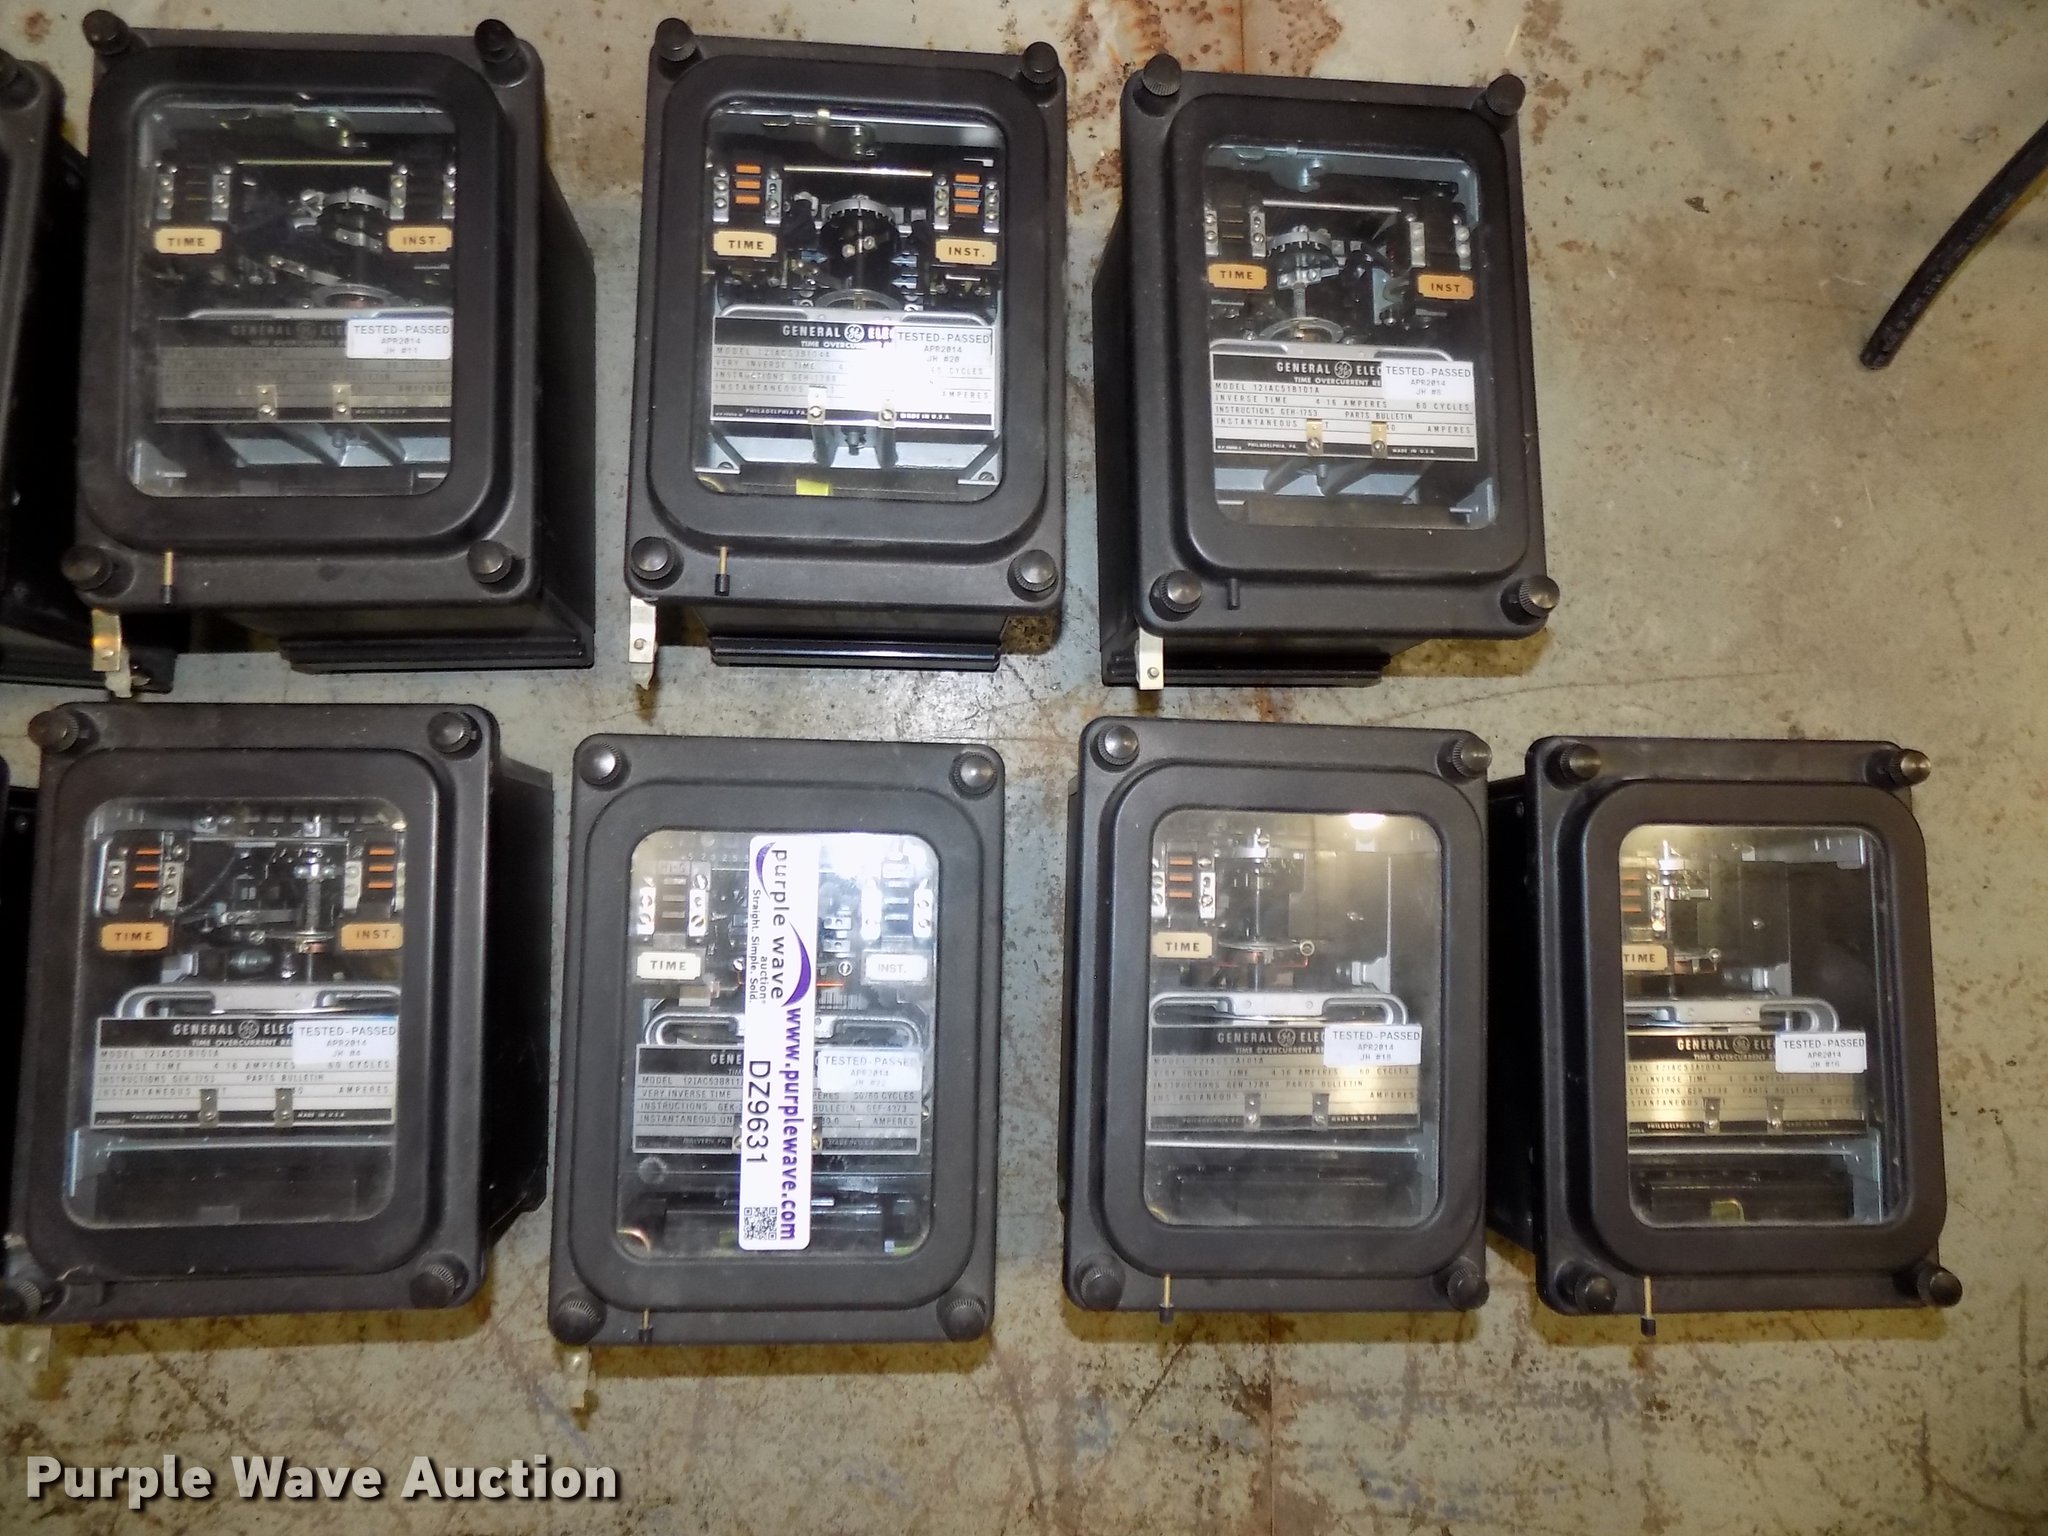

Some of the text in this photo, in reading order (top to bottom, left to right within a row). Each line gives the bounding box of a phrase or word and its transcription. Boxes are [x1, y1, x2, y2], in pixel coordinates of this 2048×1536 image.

[167, 236, 205, 248] TIME
[728, 240, 764, 250] TIME
[948, 246, 986, 258] INST.
[1220, 270, 1254, 280] TIME
[1430, 283, 1464, 292] INST.
[354, 325, 450, 334] TESTED-PASSED
[782, 325, 840, 338] GENERAL
[897, 332, 990, 344] TESTED-PASSED
[716, 347, 751, 356] MODEL
[716, 358, 738, 366] VERY
[747, 360, 786, 368] INVERSE
[794, 361, 815, 370] TIME
[1276, 362, 1331, 374] GENERAL
[715, 371, 785, 380] INSTRUCTIONS
[1386, 366, 1471, 378] TESTED-PASSED
[1215, 382, 1246, 390] MODEL
[1314, 378, 1368, 386] OVERCURRENT
[715, 384, 803, 392] INSTANTANEOUS
[1216, 394, 1258, 402] INVERSE
[1265, 396, 1288, 404] TIME
[1344, 400, 1387, 408] AMPERES
[1434, 402, 1470, 411] CYCLES
[1216, 405, 1275, 414] INSTRUCTIONS
[1345, 411, 1370, 419] PARTS
[1376, 412, 1412, 420] BULLETIN
[1216, 417, 1471, 434] INSTANTANEOUS AMPERES
[769, 850, 790, 999] purple wave
[115, 932, 152, 941] TIME
[749, 889, 761, 1003] Straight. Simple. Sold.
[1165, 942, 1200, 952] TIME
[1624, 954, 1656, 962] TIME
[650, 960, 686, 971] TIME
[172, 1024, 234, 1036] GENERAL
[300, 1026, 396, 1036] TESTED-PASSED
[1217, 1032, 1273, 1044] GENERAL
[1334, 1031, 1420, 1040] TESTED-PASSED
[216, 1039, 276, 1047] OVERCURRENT
[1677, 1039, 1730, 1051] GENERAL
[1784, 1038, 1864, 1048] TESTED-PASSED
[101, 1050, 134, 1058] MODEL
[156, 1062, 181, 1070] TIME
[245, 1061, 296, 1069] AMPERES
[348, 1060, 390, 1068] CYCLES
[246, 1074, 274, 1082] PARTS
[282, 1074, 324, 1082] BULLETIN
[642, 1076, 672, 1085] MODEL
[98, 1086, 389, 1096] INSTANTANEOUS AMPERES
[642, 1090, 664, 1098] VERY
[668, 1090, 706, 1098] INVERSE
[710, 1090, 731, 1098] TIME
[882, 1092, 914, 1100] CYCLES
[641, 1102, 708, 1111] INSTRUCTIONS
[746, 1060, 771, 1162] DZ9631
[641, 1114, 914, 1126] INSTANTANEOUS AMPERES
[778, 1008, 804, 1240] www.purplewave.com
